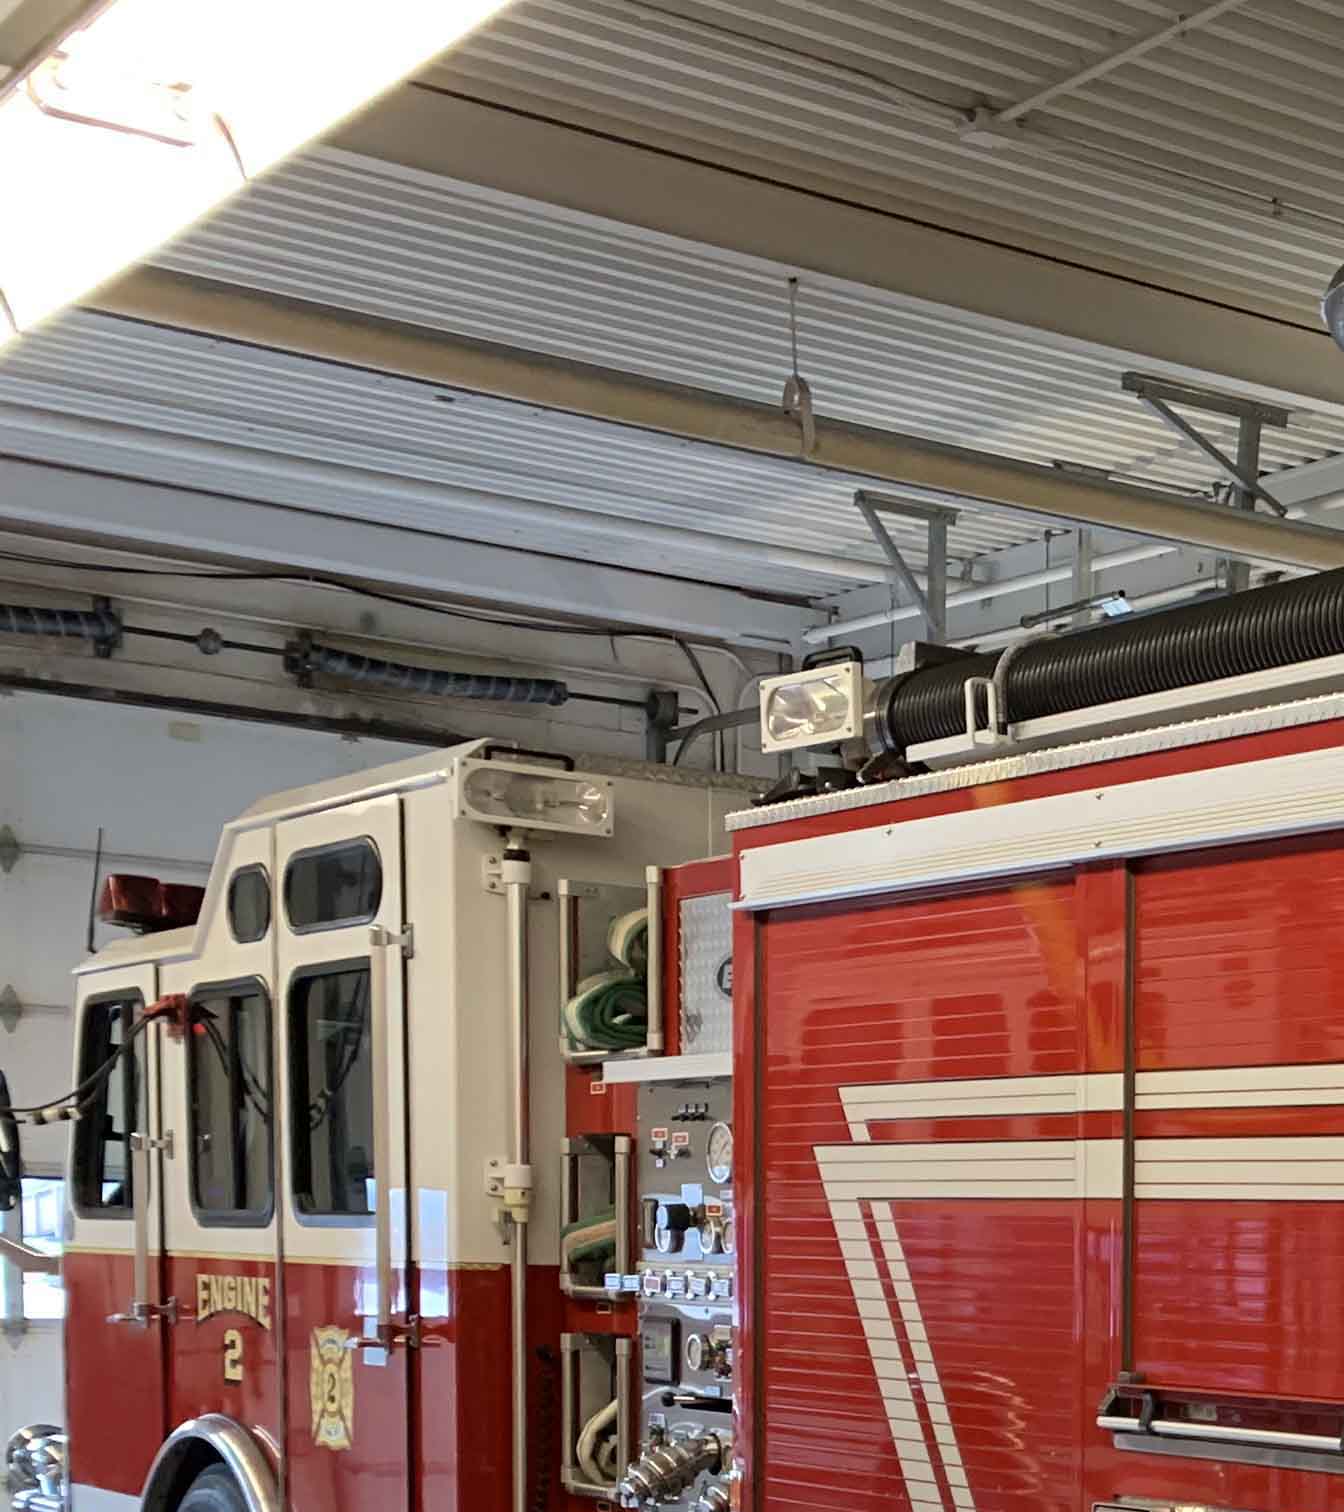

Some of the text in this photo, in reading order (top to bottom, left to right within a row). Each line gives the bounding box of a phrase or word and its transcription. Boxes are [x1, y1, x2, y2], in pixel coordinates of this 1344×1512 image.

[196, 1274, 271, 1330] ENGINE
[224, 1329, 244, 1385] 2
[327, 1373, 337, 1404] 2
